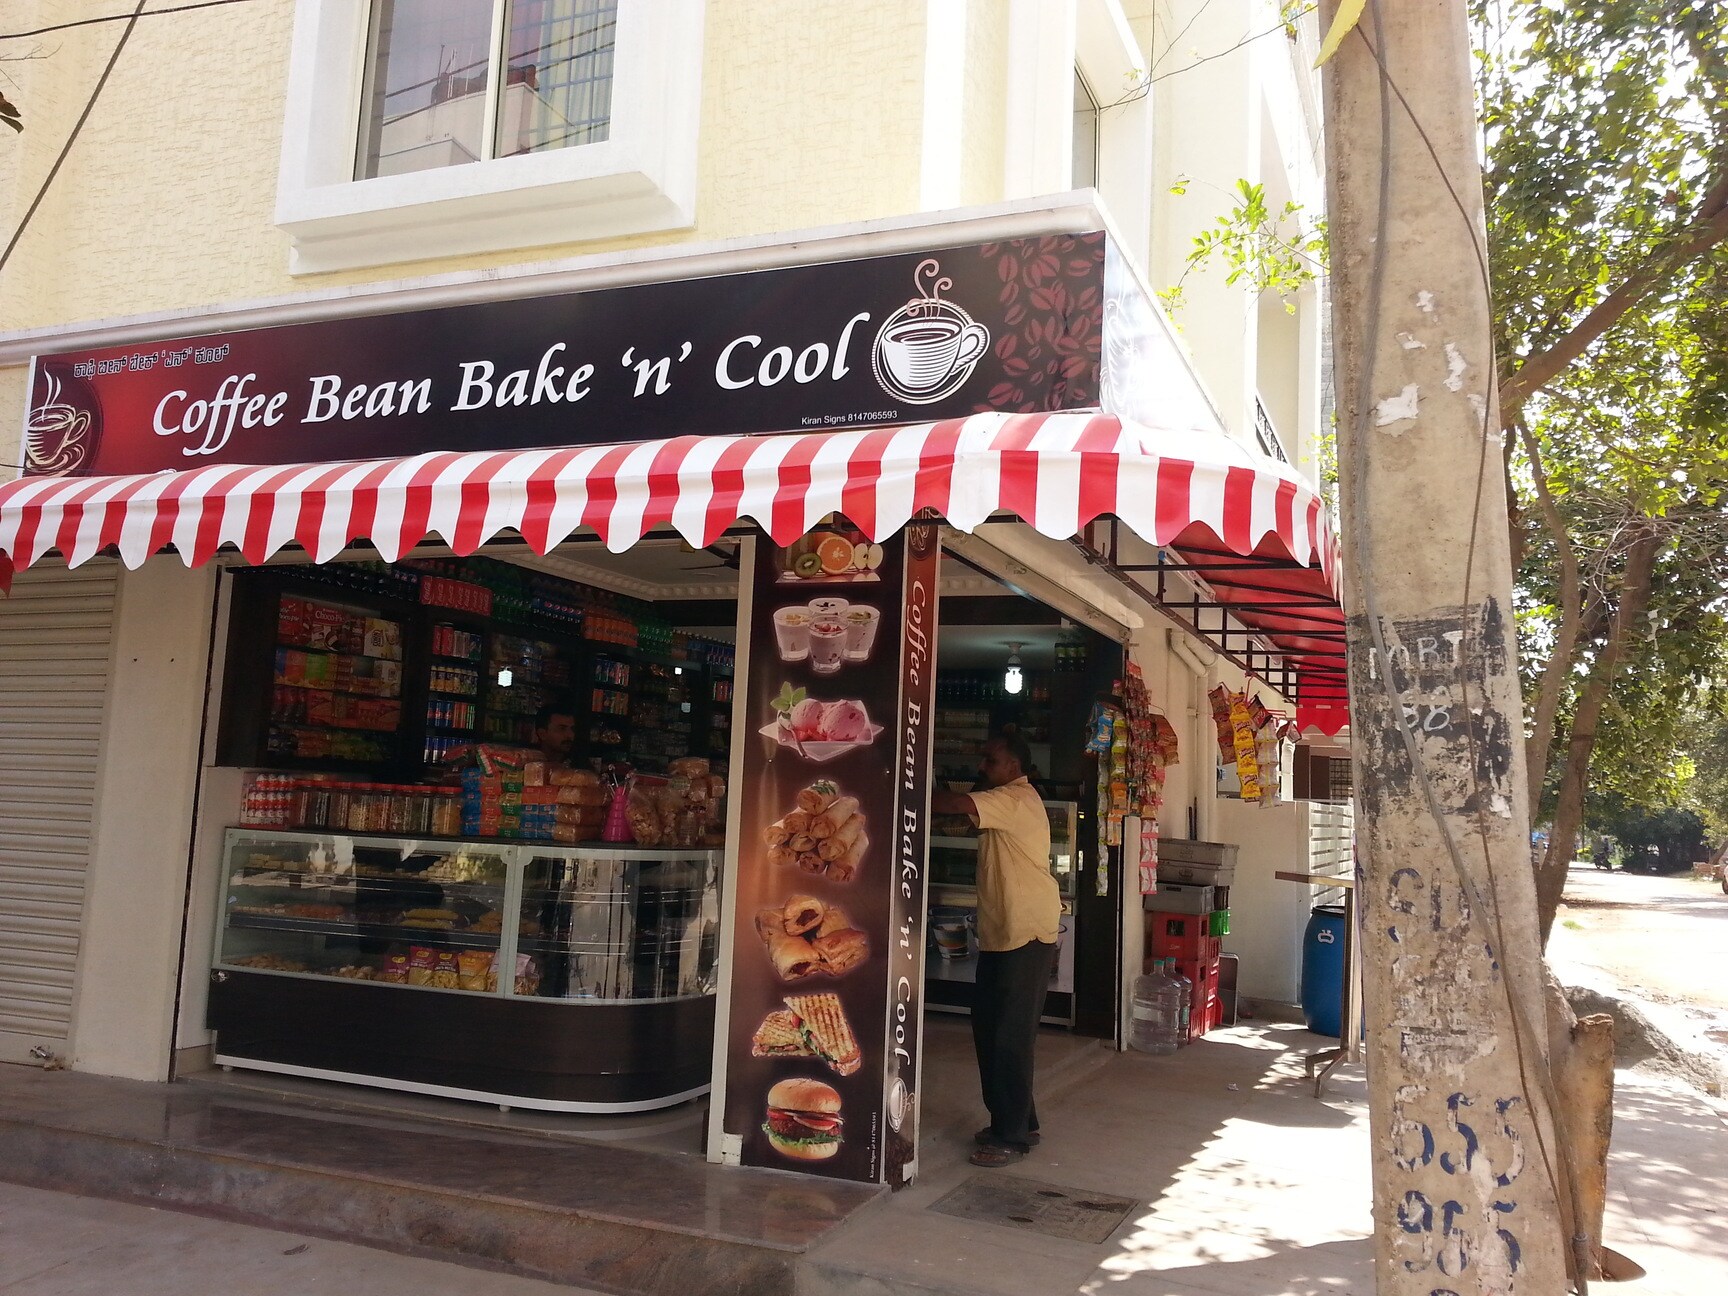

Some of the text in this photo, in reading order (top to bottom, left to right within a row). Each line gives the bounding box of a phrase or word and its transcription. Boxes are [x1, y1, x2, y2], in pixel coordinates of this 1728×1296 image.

[153, 372, 288, 457] Coffee
[300, 374, 432, 424] Bean
[450, 342, 595, 411] Bake
[715, 311, 871, 390] Cool
[801, 410, 898, 426] Kiran Signs 8147065593
[906, 579, 927, 687] Coffee
[904, 697, 922, 791] Bean
[901, 804, 919, 899] Bake
[894, 976, 911, 1066] Cool
